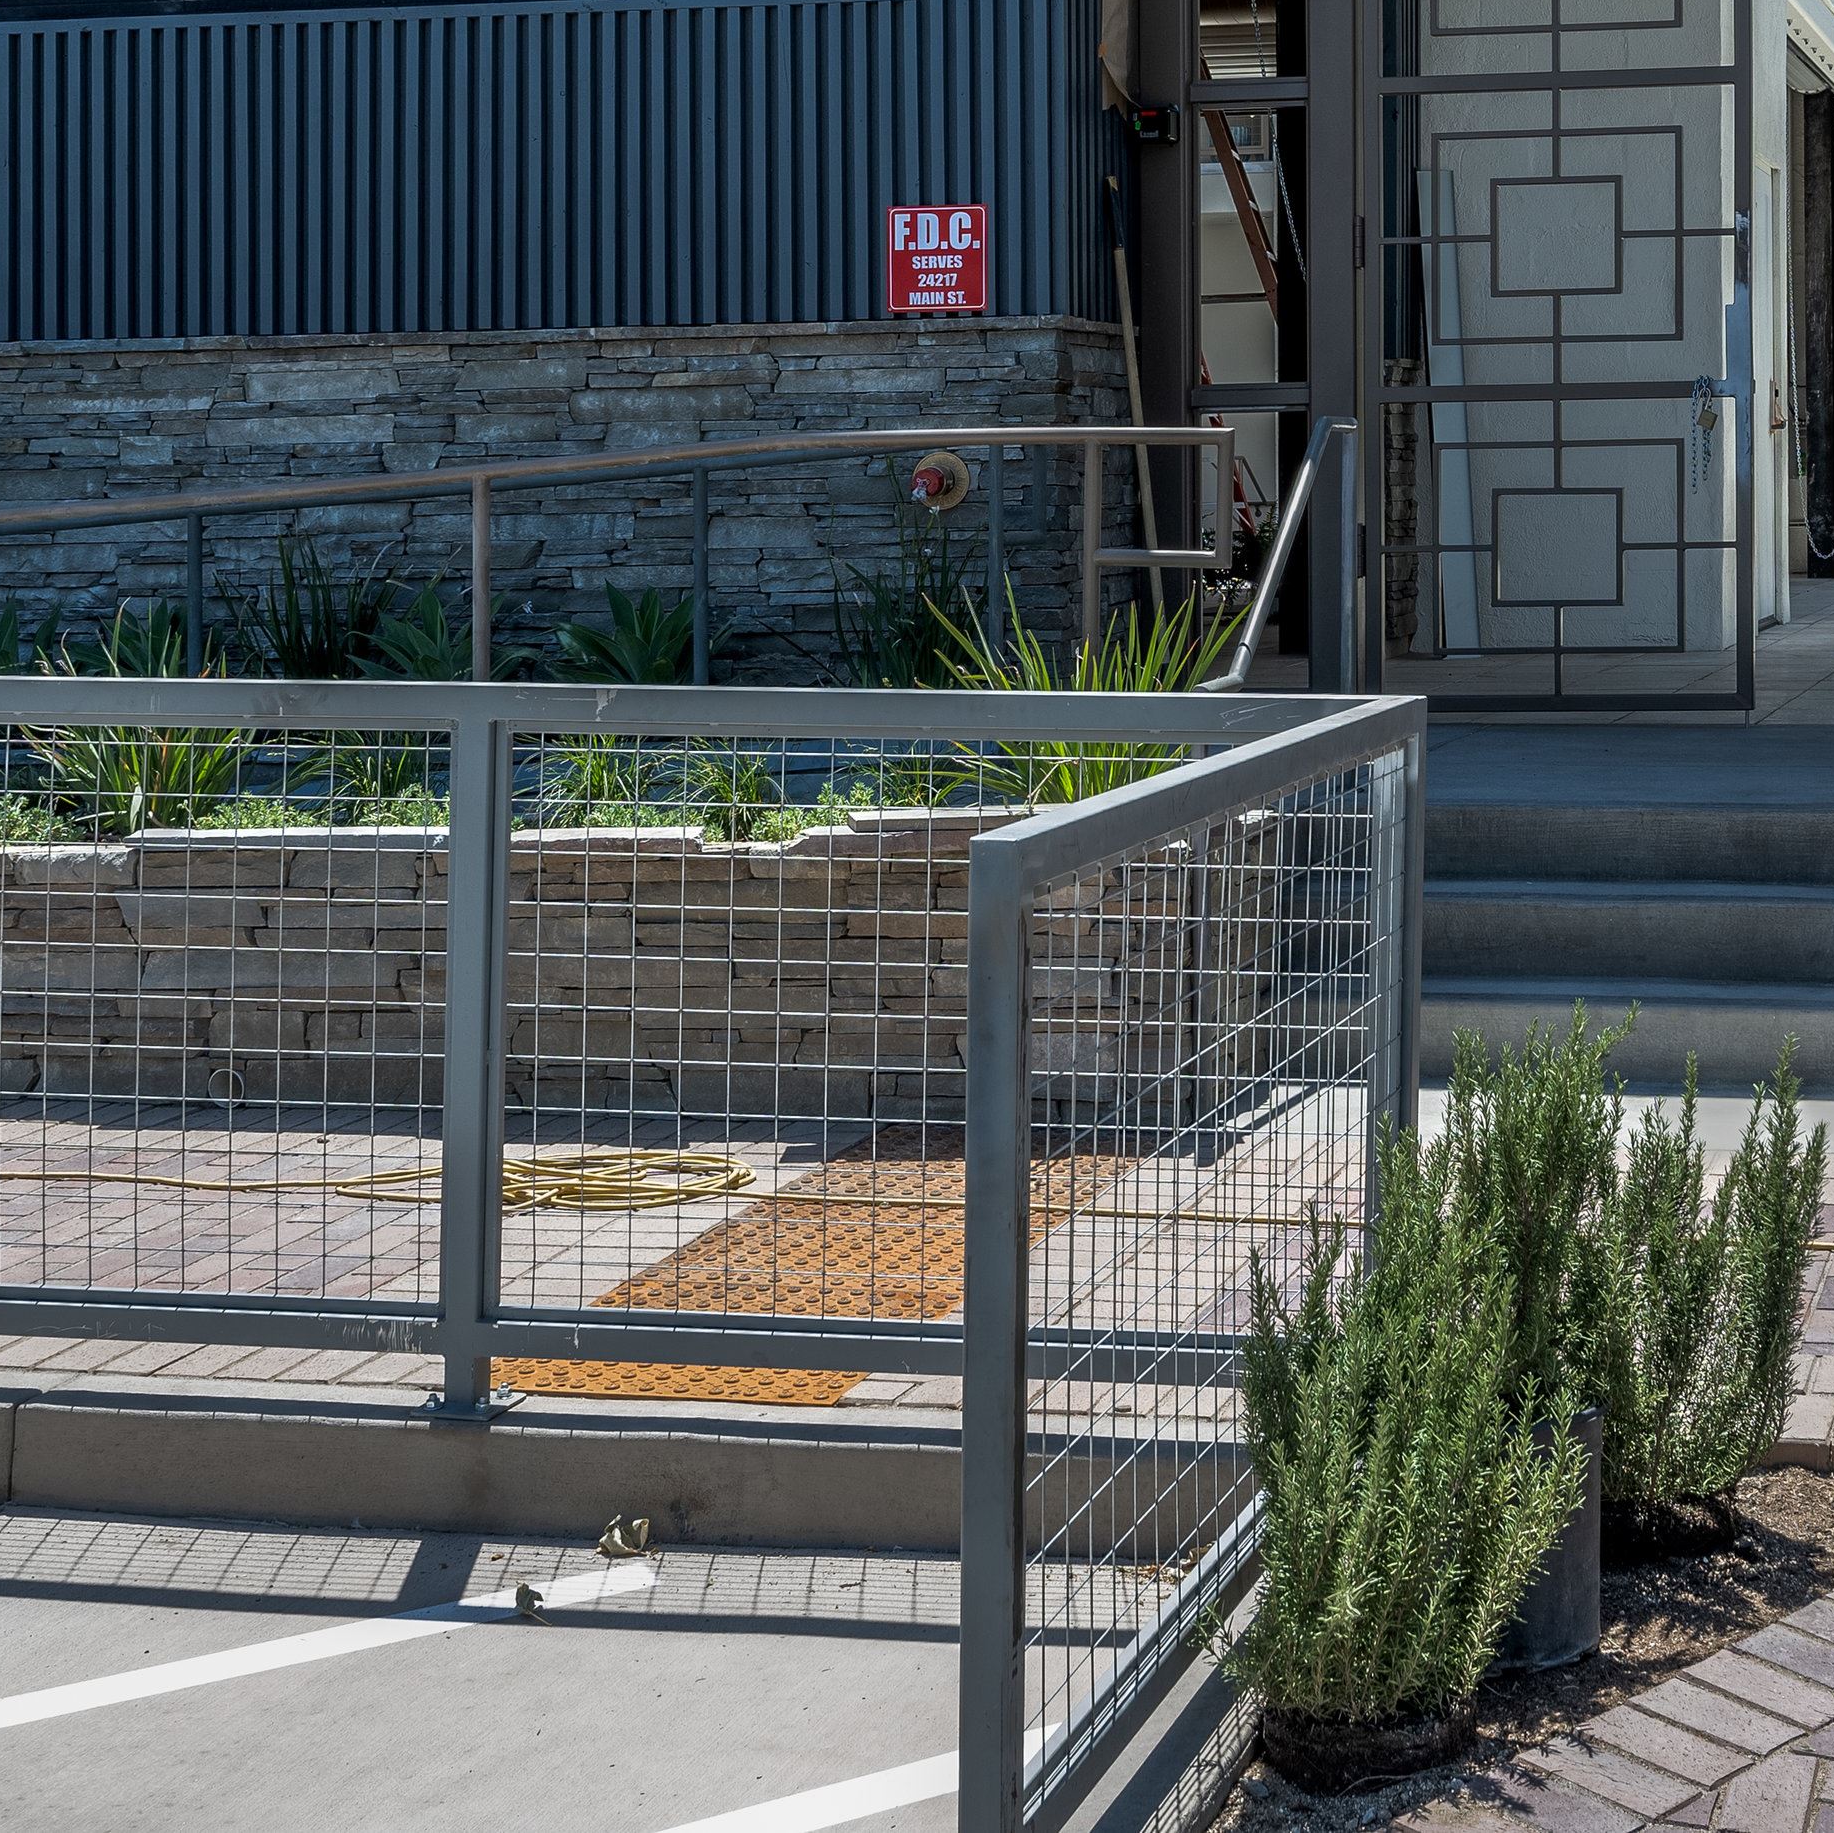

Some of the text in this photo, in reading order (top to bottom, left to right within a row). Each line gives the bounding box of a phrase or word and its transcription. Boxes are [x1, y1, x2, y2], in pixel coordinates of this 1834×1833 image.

[894, 211, 980, 250] F.D.C.
[912, 255, 963, 269] SERVES
[918, 273, 957, 287] 24217
[909, 291, 966, 305] MAIN ST.
